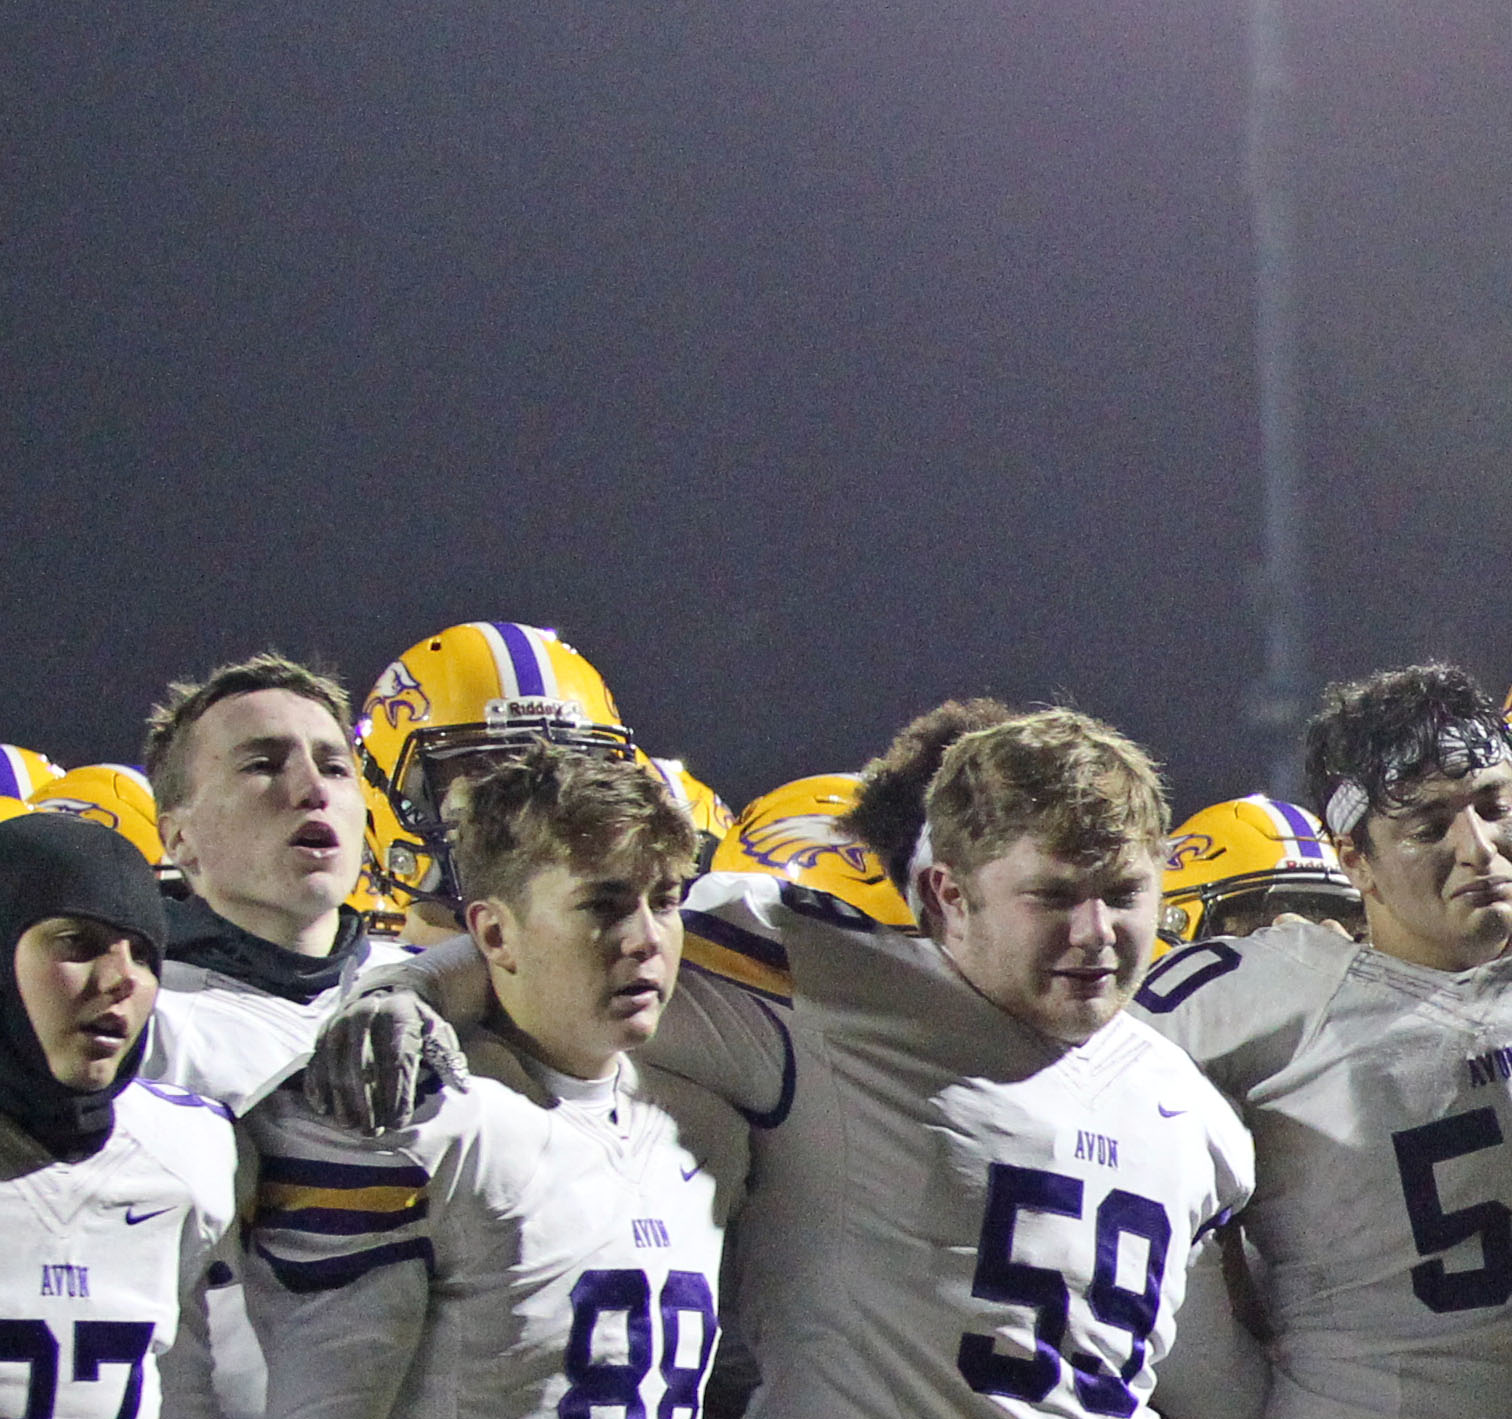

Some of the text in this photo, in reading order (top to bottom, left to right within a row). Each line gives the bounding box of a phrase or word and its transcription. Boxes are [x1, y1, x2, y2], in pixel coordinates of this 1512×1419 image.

[1074, 1129, 1119, 1169] AVON
[631, 1218, 670, 1248] AVON
[41, 1263, 90, 1298] AVON
[957, 1162, 1172, 1419] 59
